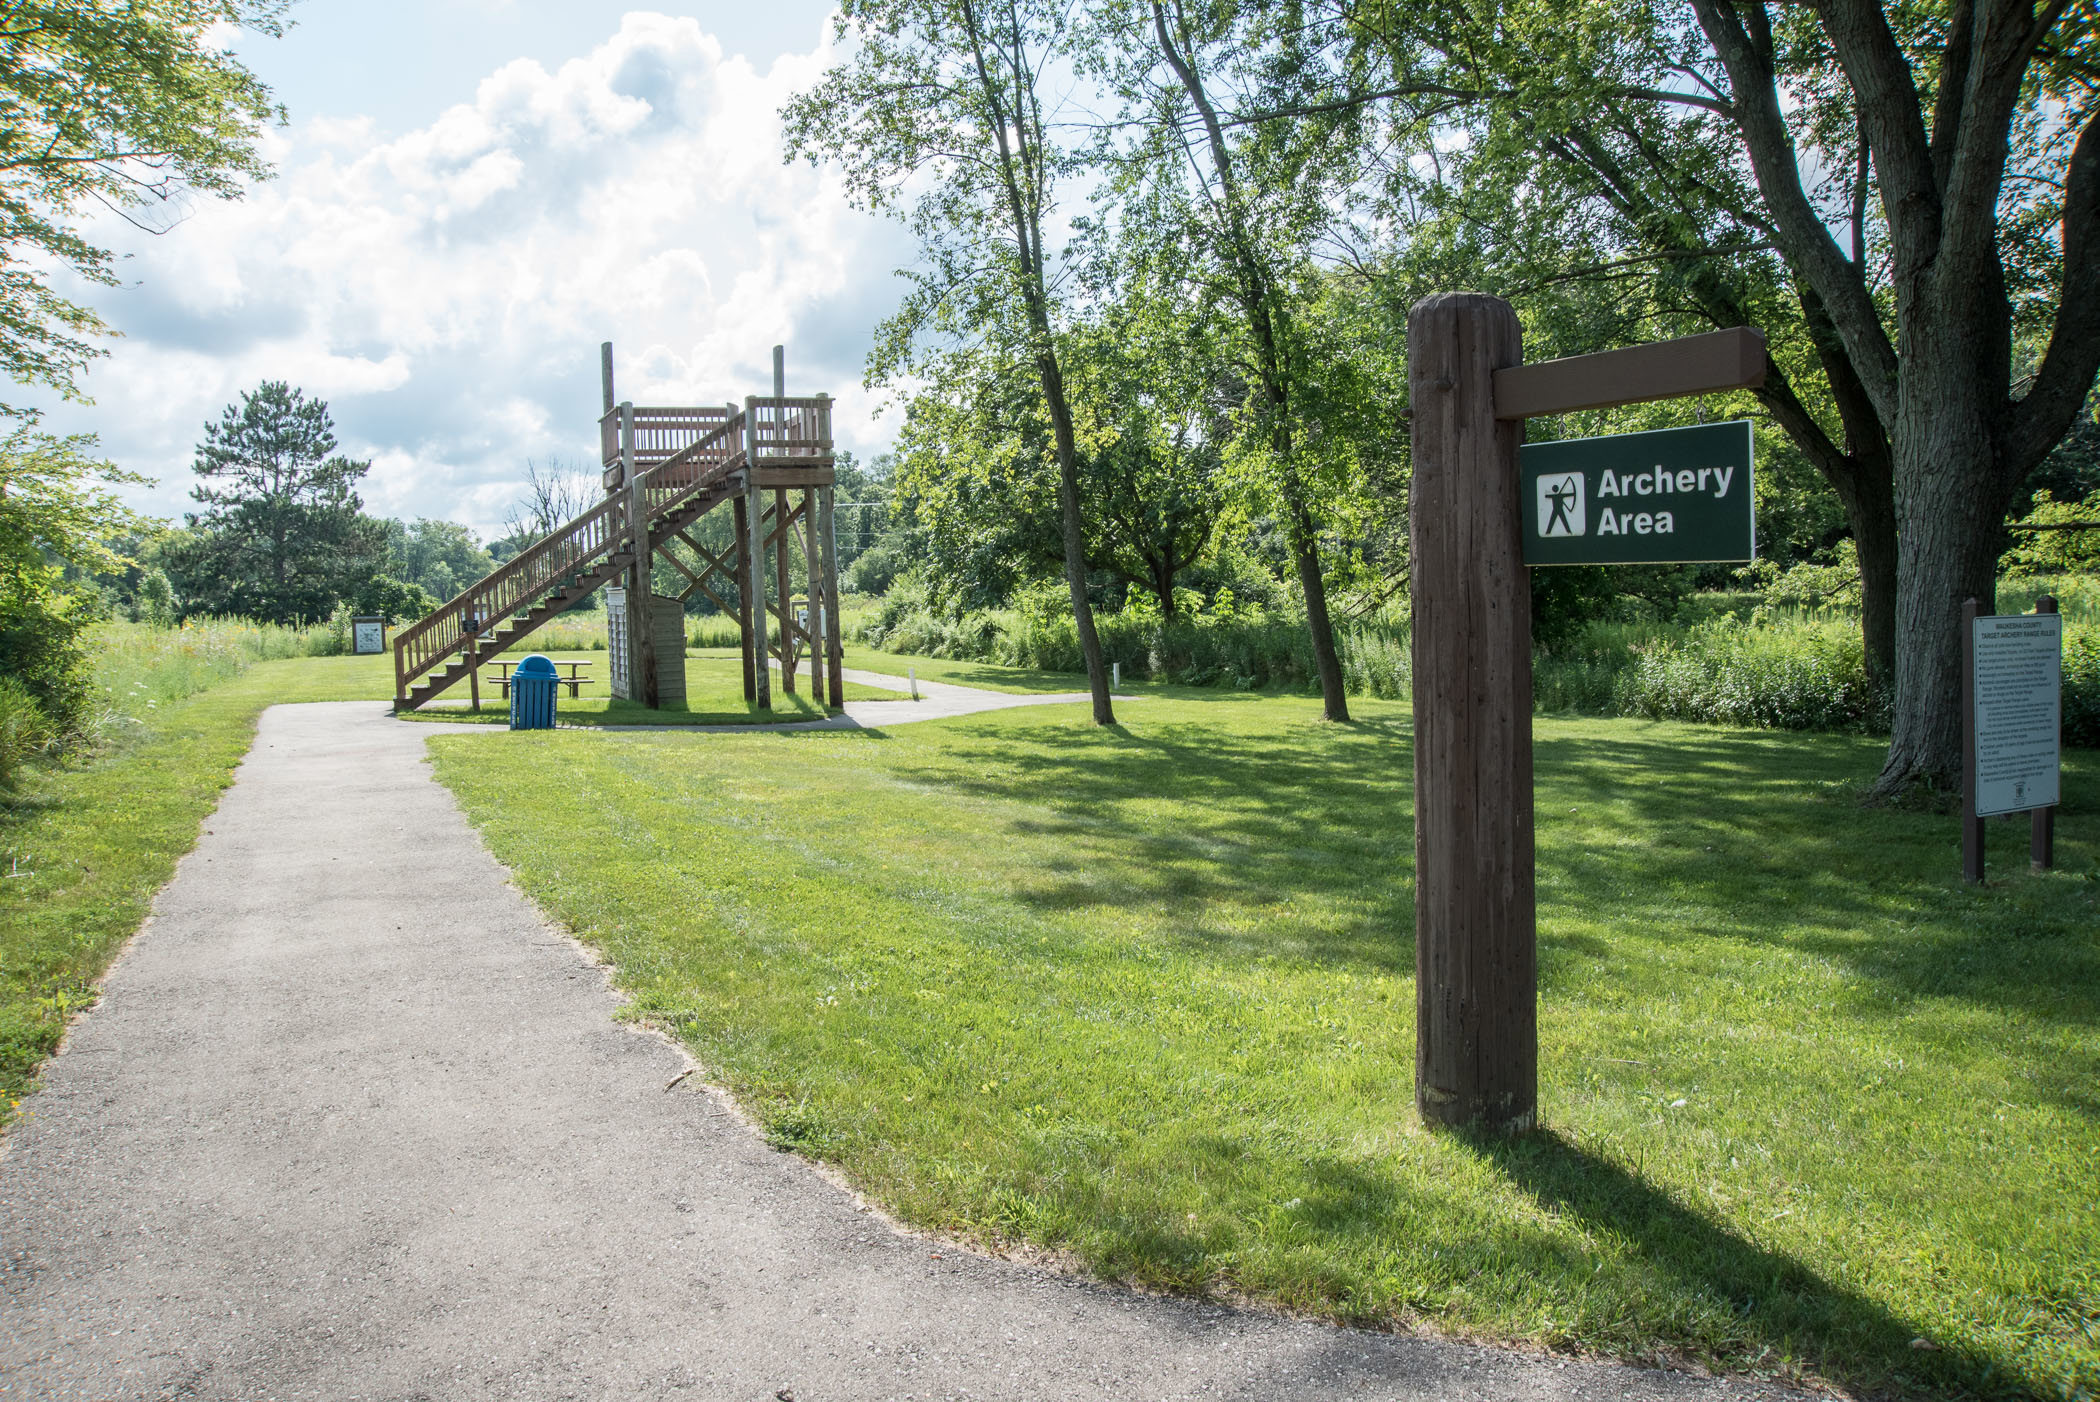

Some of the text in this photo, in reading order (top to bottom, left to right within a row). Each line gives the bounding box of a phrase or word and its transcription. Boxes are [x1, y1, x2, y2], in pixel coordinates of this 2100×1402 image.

[1597, 464, 1734, 498] Archery
[1597, 507, 1674, 536] Area
[2000, 631, 2022, 639] ARCHERY
[2040, 629, 2056, 637] RULES
